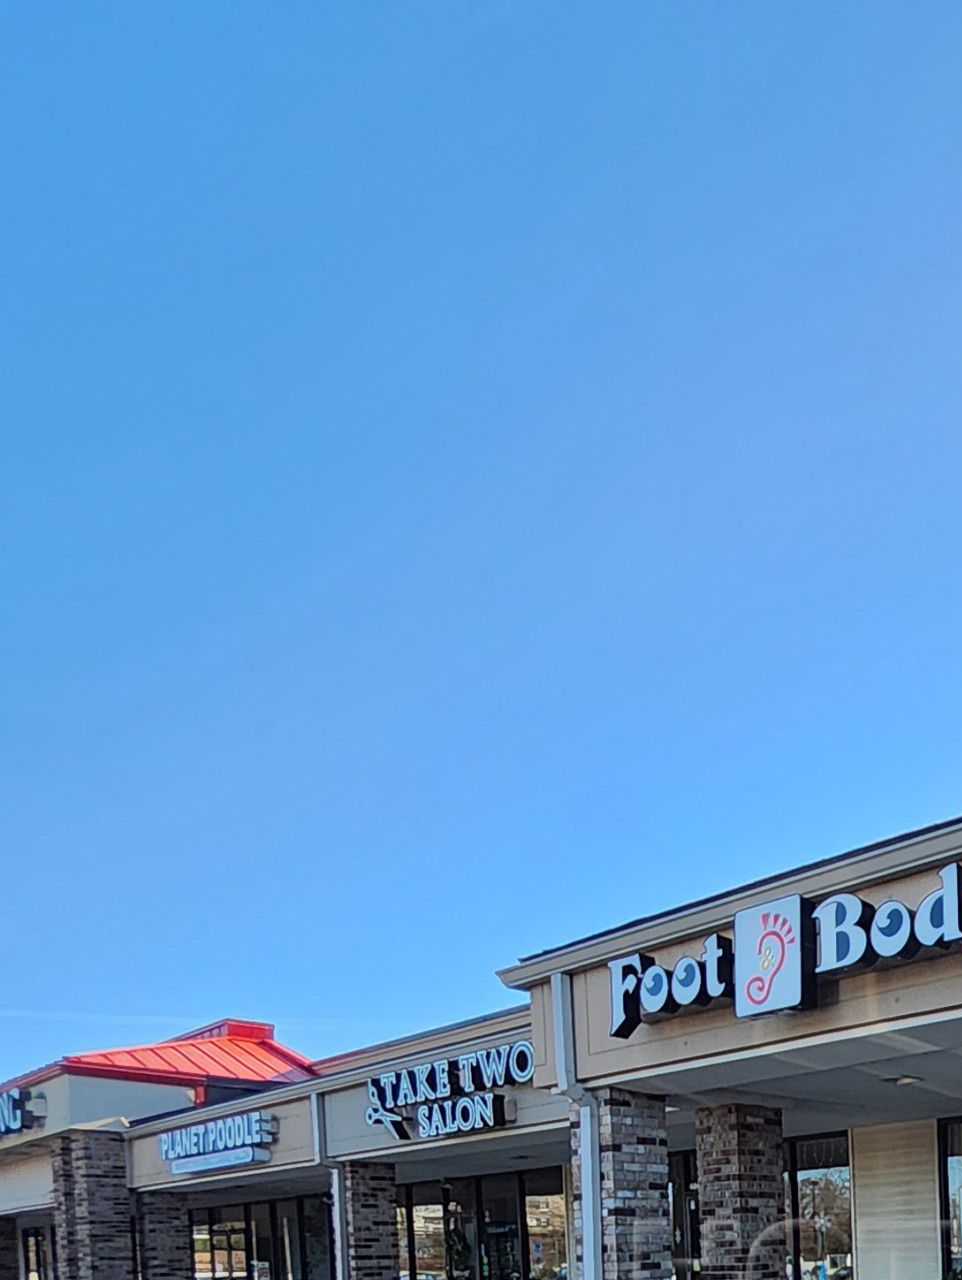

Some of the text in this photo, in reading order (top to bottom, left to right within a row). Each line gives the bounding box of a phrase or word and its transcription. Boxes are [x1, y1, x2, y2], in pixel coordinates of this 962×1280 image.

[607, 934, 726, 1038] Foot
[380, 1040, 534, 1108] TAKE TWO
[160, 1110, 262, 1160] PLANET POODLE
[417, 1092, 495, 1138] SALON
